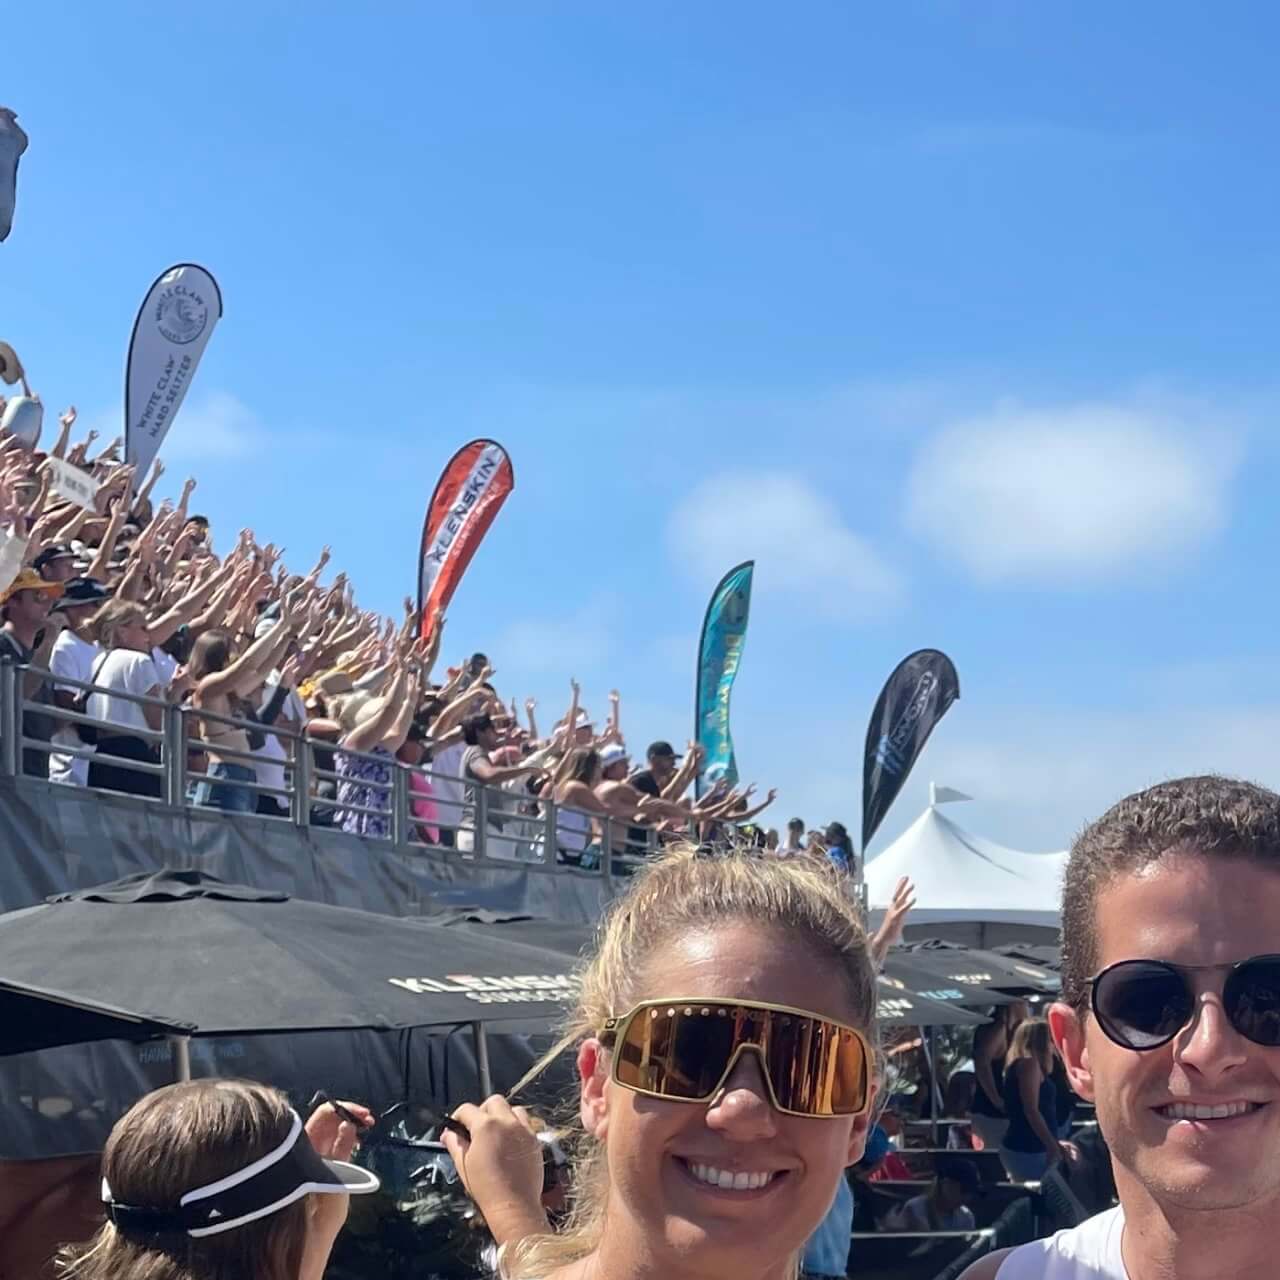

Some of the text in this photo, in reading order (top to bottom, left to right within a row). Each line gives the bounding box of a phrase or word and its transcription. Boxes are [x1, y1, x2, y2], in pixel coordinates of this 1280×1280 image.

[137, 355, 175, 430] WHITE CLAW
[149, 405, 170, 438] HARD
[166, 354, 192, 406] SELTZER
[429, 457, 497, 564] KLENSKIN
